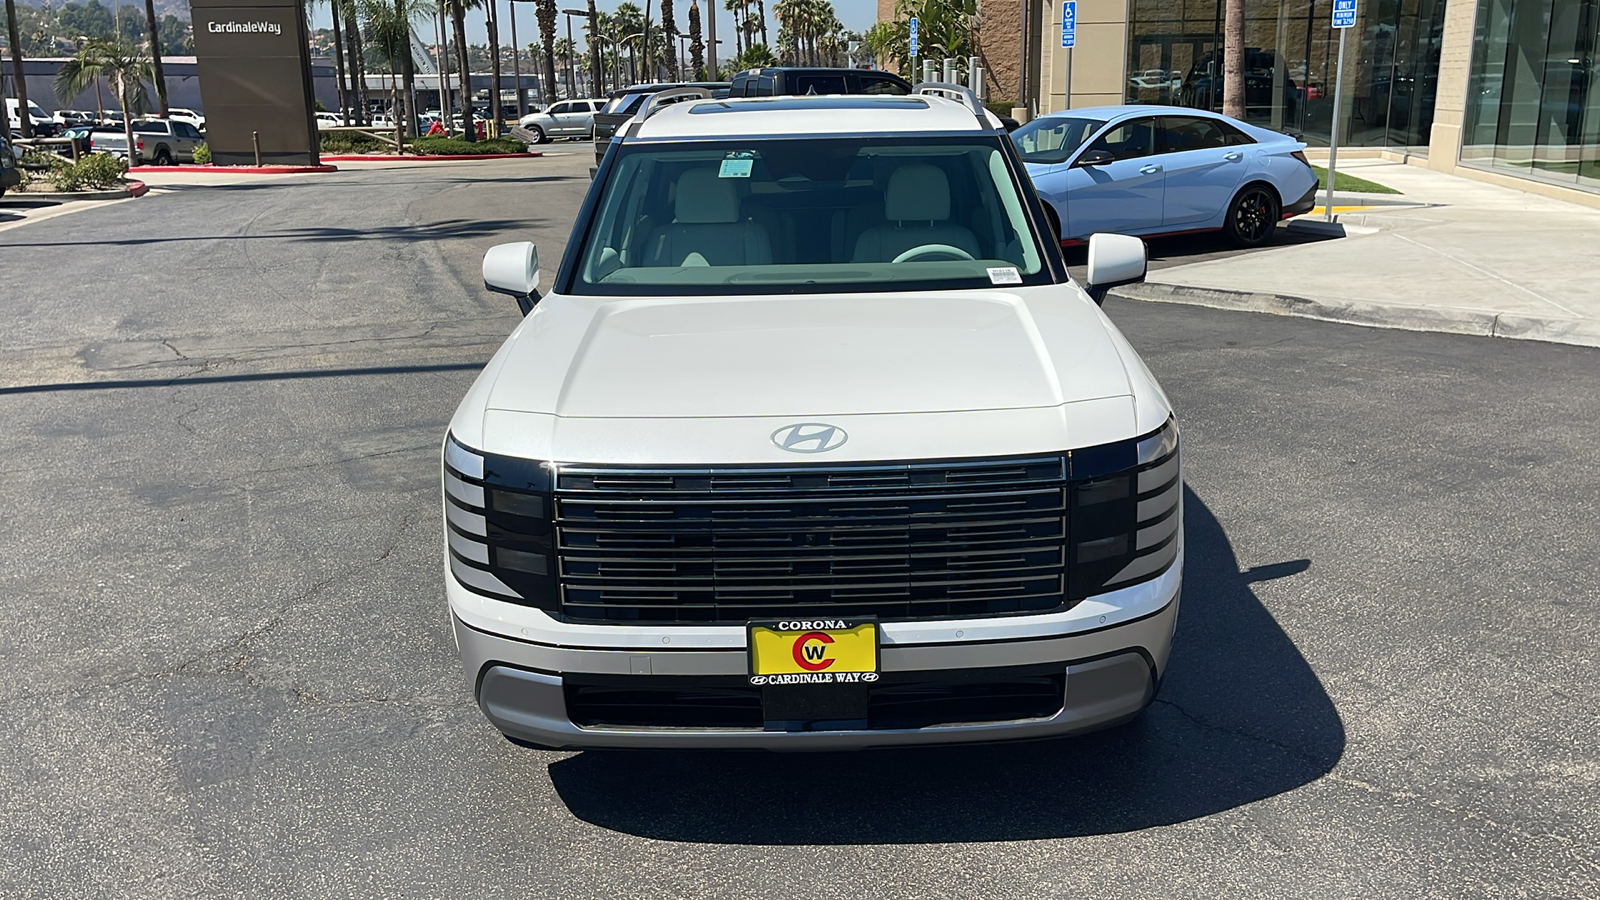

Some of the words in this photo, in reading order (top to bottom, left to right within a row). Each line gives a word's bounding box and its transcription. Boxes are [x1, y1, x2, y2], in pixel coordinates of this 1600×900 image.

[1338, 1, 1352, 10] ONLY
[207, 21, 281, 35] CardinaleWay
[778, 619, 847, 631] CORONA
[768, 674, 833, 685] CARDINALE
[835, 672, 861, 683] WAY
